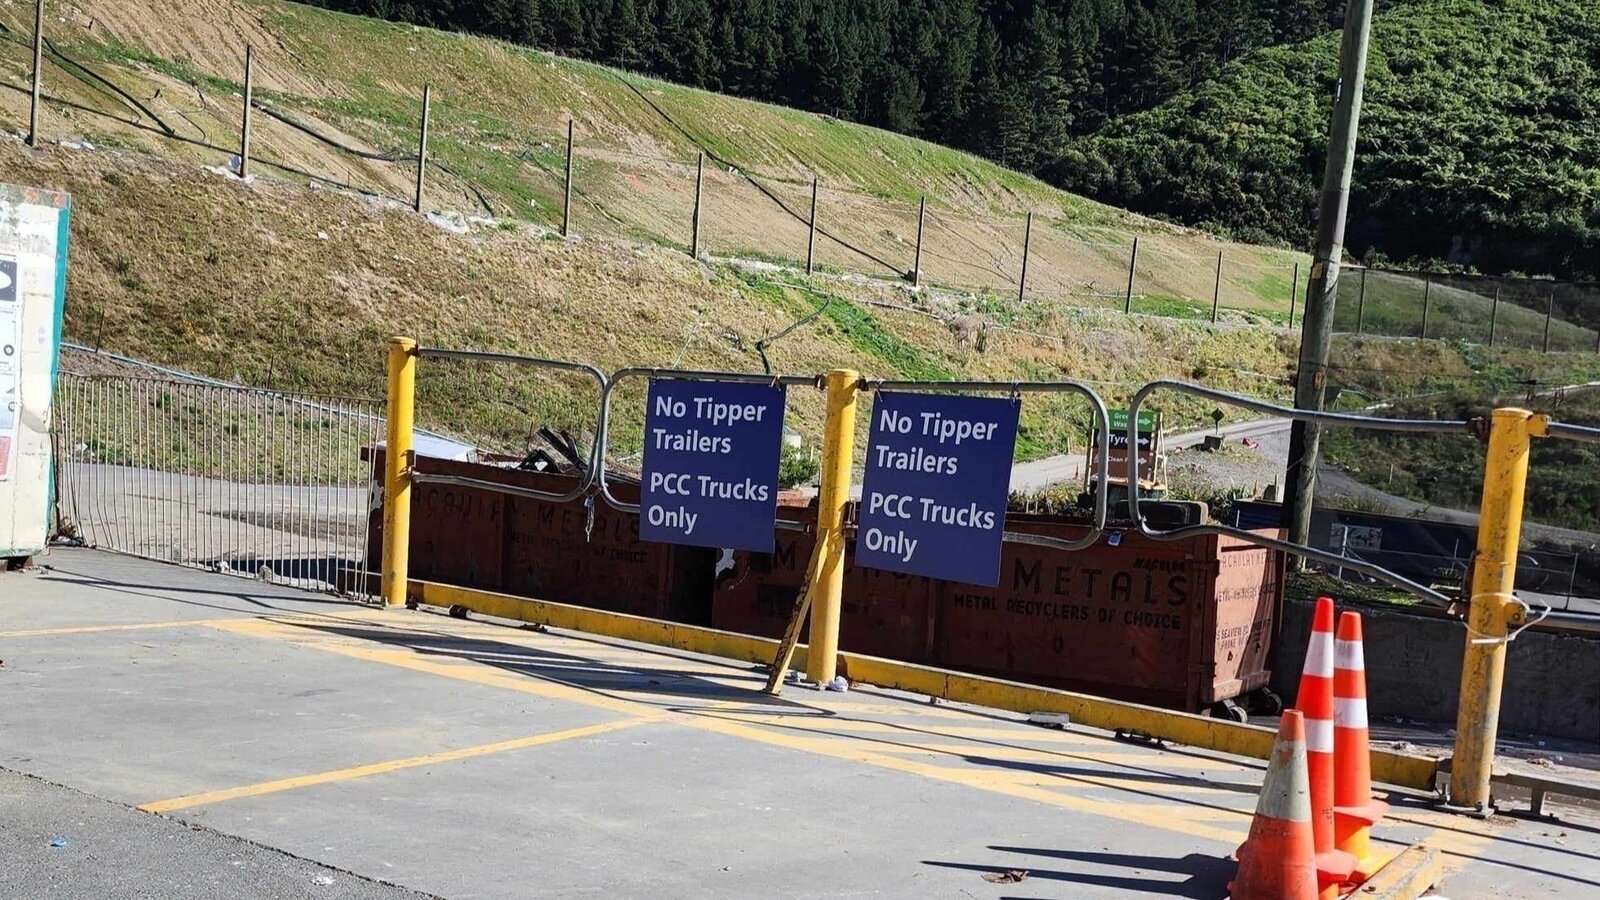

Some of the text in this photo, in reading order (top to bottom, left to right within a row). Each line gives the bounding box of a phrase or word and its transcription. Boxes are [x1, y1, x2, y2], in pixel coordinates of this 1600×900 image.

[655, 396, 767, 427] No Tipper
[879, 409, 998, 445] No Tipper
[653, 428, 732, 454] Trailers
[876, 445, 958, 475] Trailers
[650, 472, 769, 501] PCC Trucks
[648, 504, 698, 535] Only
[869, 492, 995, 530] PCC Trucks
[865, 527, 918, 562] Only
[1013, 557, 1187, 606] METALS
[954, 593, 1181, 629] METAL RECYCLERS OF CHOICE
